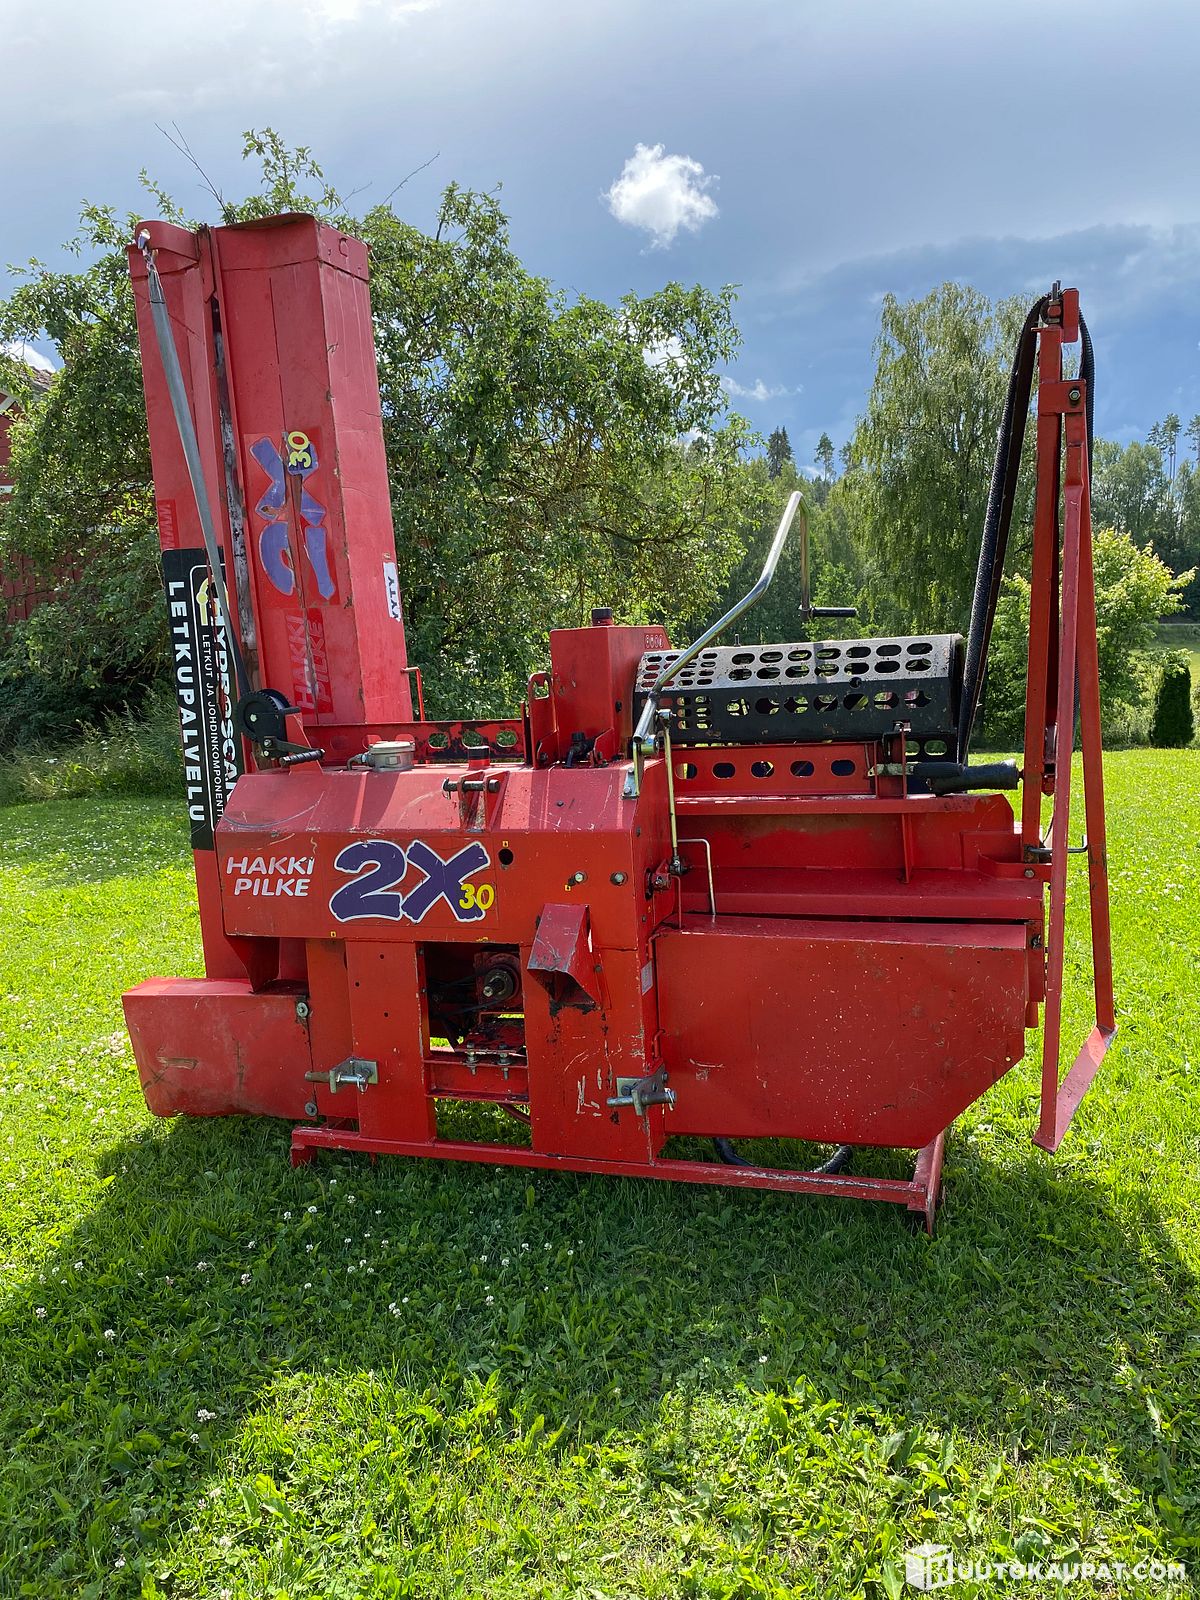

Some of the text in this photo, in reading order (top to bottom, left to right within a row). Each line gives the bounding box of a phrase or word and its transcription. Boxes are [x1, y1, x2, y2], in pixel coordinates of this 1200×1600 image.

[288, 431, 312, 469] 30
[168, 581, 205, 821] LETKUPALVELU
[285, 615, 316, 709] HAKKI
[307, 620, 331, 704] PILKE
[202, 634, 224, 822] LETKUT JA JOHDINKOMPONENTI
[226, 856, 315, 876] HAKKI
[234, 878, 311, 897] PILKE
[329, 839, 495, 923] 2X 30
